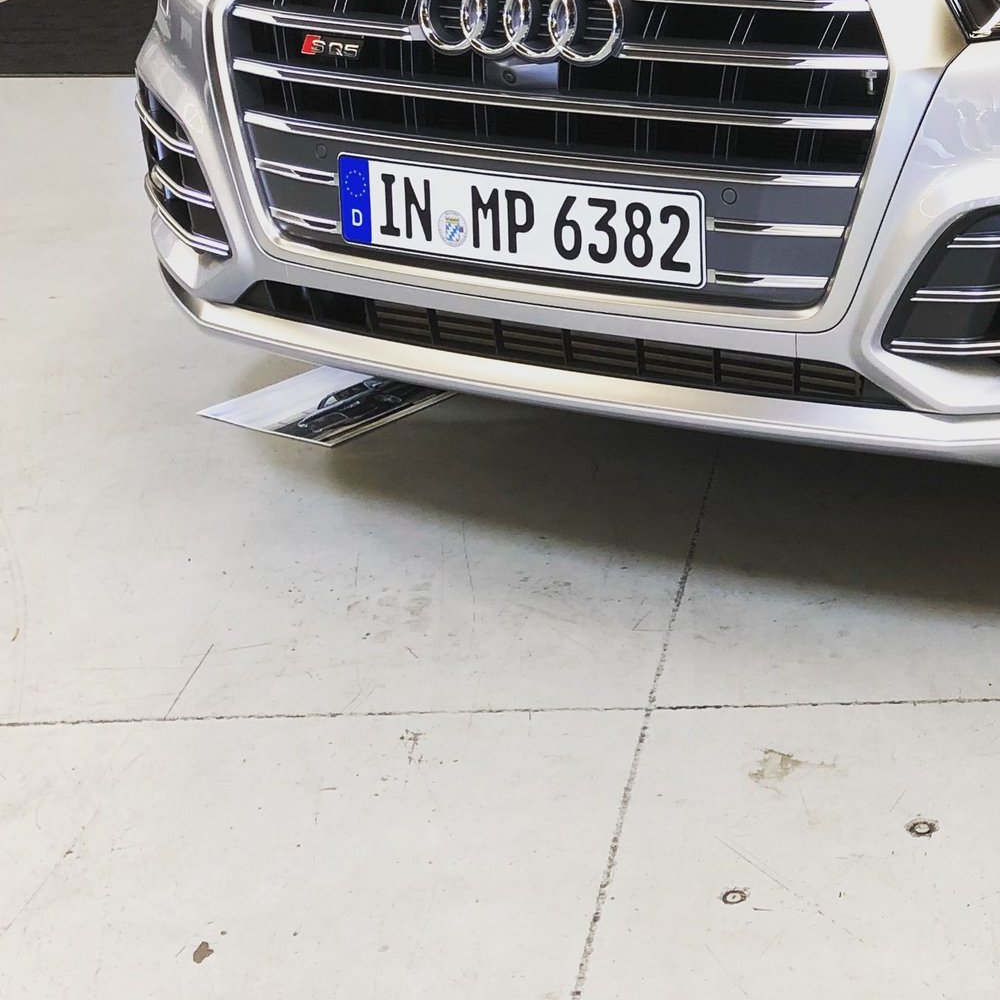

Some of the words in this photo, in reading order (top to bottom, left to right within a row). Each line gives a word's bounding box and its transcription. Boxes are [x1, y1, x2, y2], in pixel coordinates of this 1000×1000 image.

[351, 208, 363, 227] D
[380, 173, 432, 242] IN
[471, 185, 534, 254] MP
[554, 195, 691, 273] 6382
